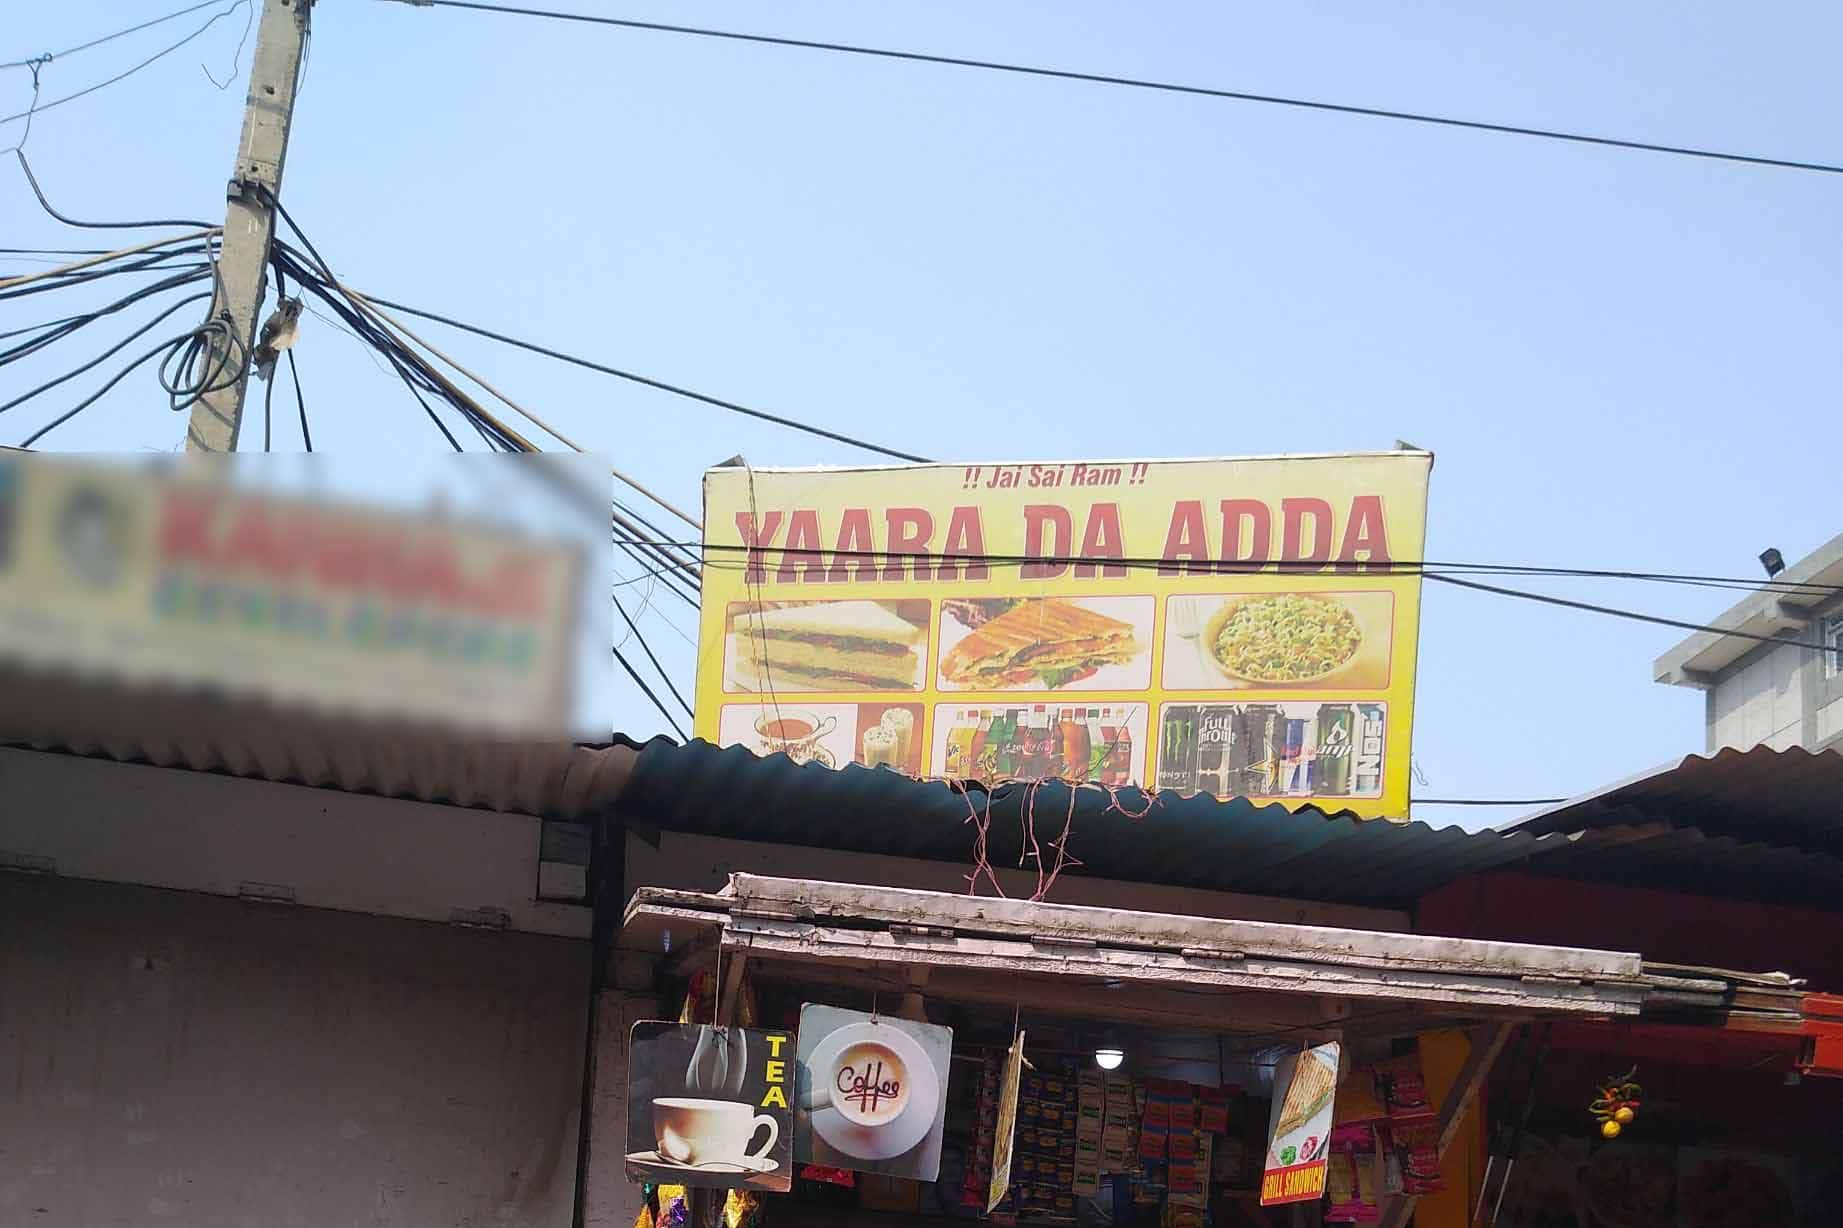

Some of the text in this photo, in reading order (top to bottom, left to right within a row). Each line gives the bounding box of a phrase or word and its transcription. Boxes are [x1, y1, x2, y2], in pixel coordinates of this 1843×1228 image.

[986, 465, 1023, 489] Jai
[1028, 464, 1065, 488] Sai
[1070, 463, 1122, 487] Ram
[735, 495, 1394, 584] YAARA DA ADDA
[760, 1035, 787, 1108] TEA
[837, 1061, 900, 1112] Coffee
[1264, 1166, 1325, 1200] GRILL SANDWICH
